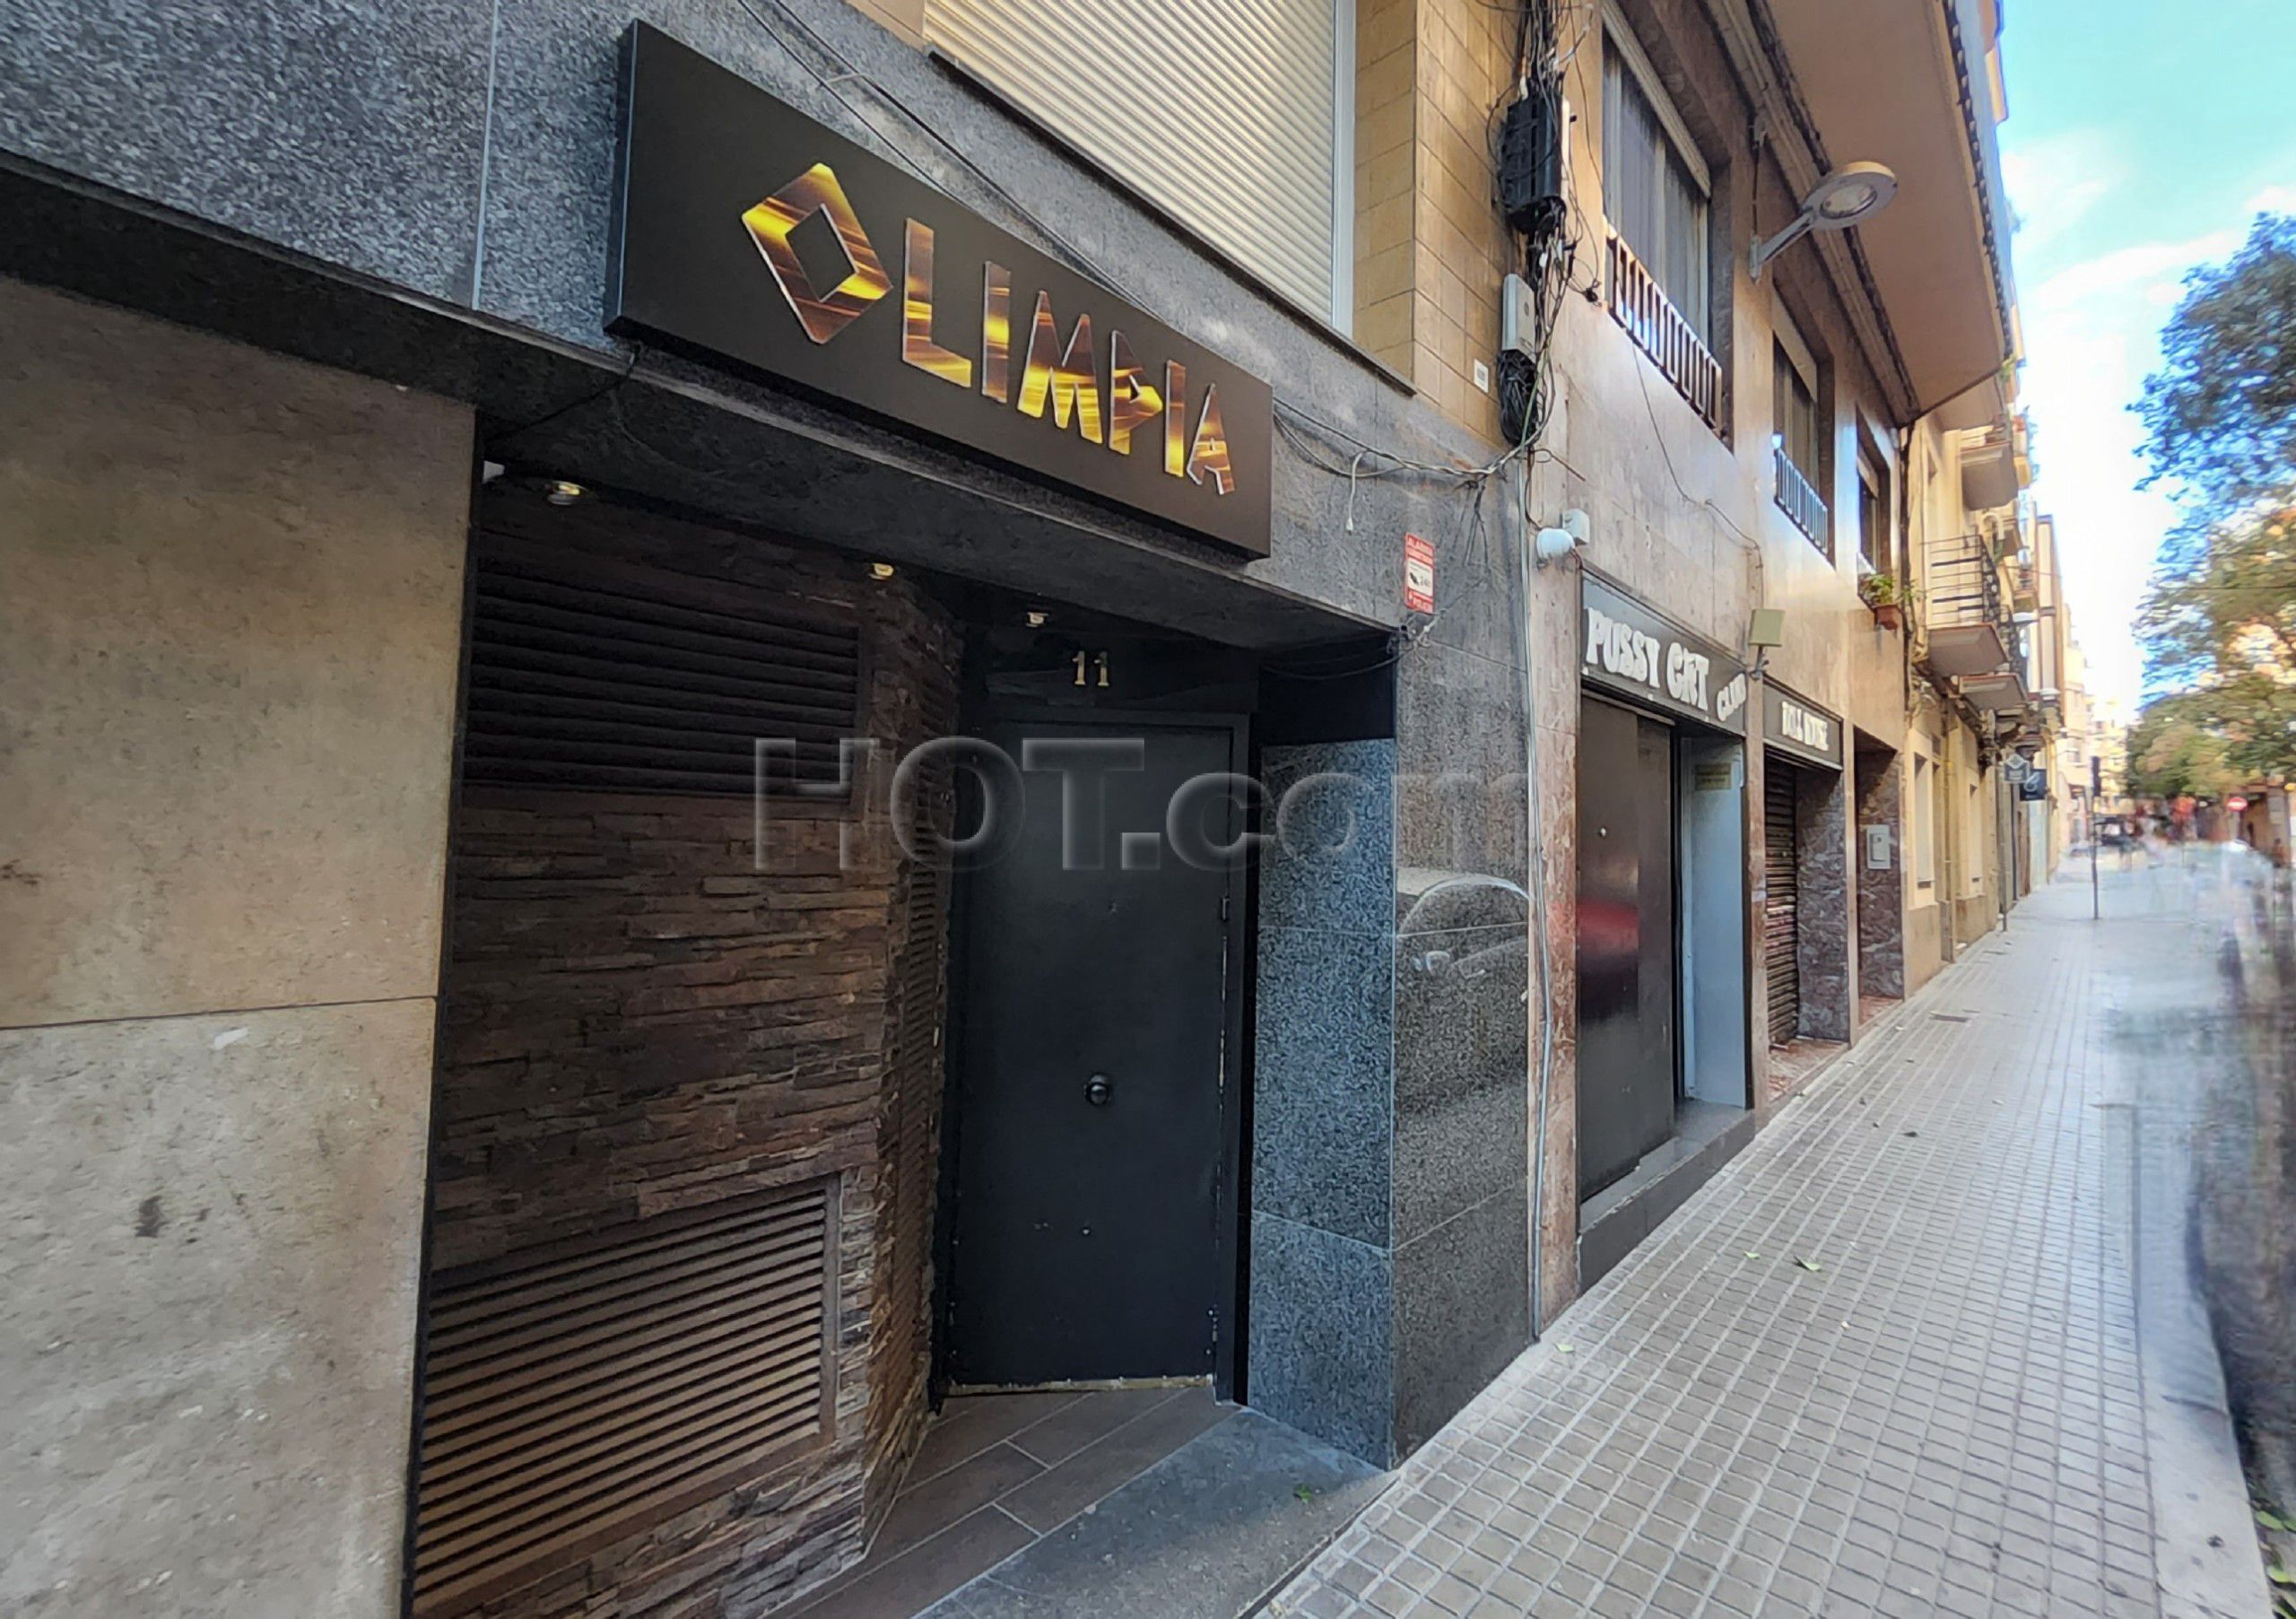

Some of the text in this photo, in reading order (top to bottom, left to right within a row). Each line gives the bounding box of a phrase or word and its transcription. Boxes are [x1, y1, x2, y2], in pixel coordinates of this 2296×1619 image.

[741, 161, 1236, 496] OLIMPIA
[1072, 650, 1109, 686] 11
[1586, 607, 1660, 689] PUSSY
